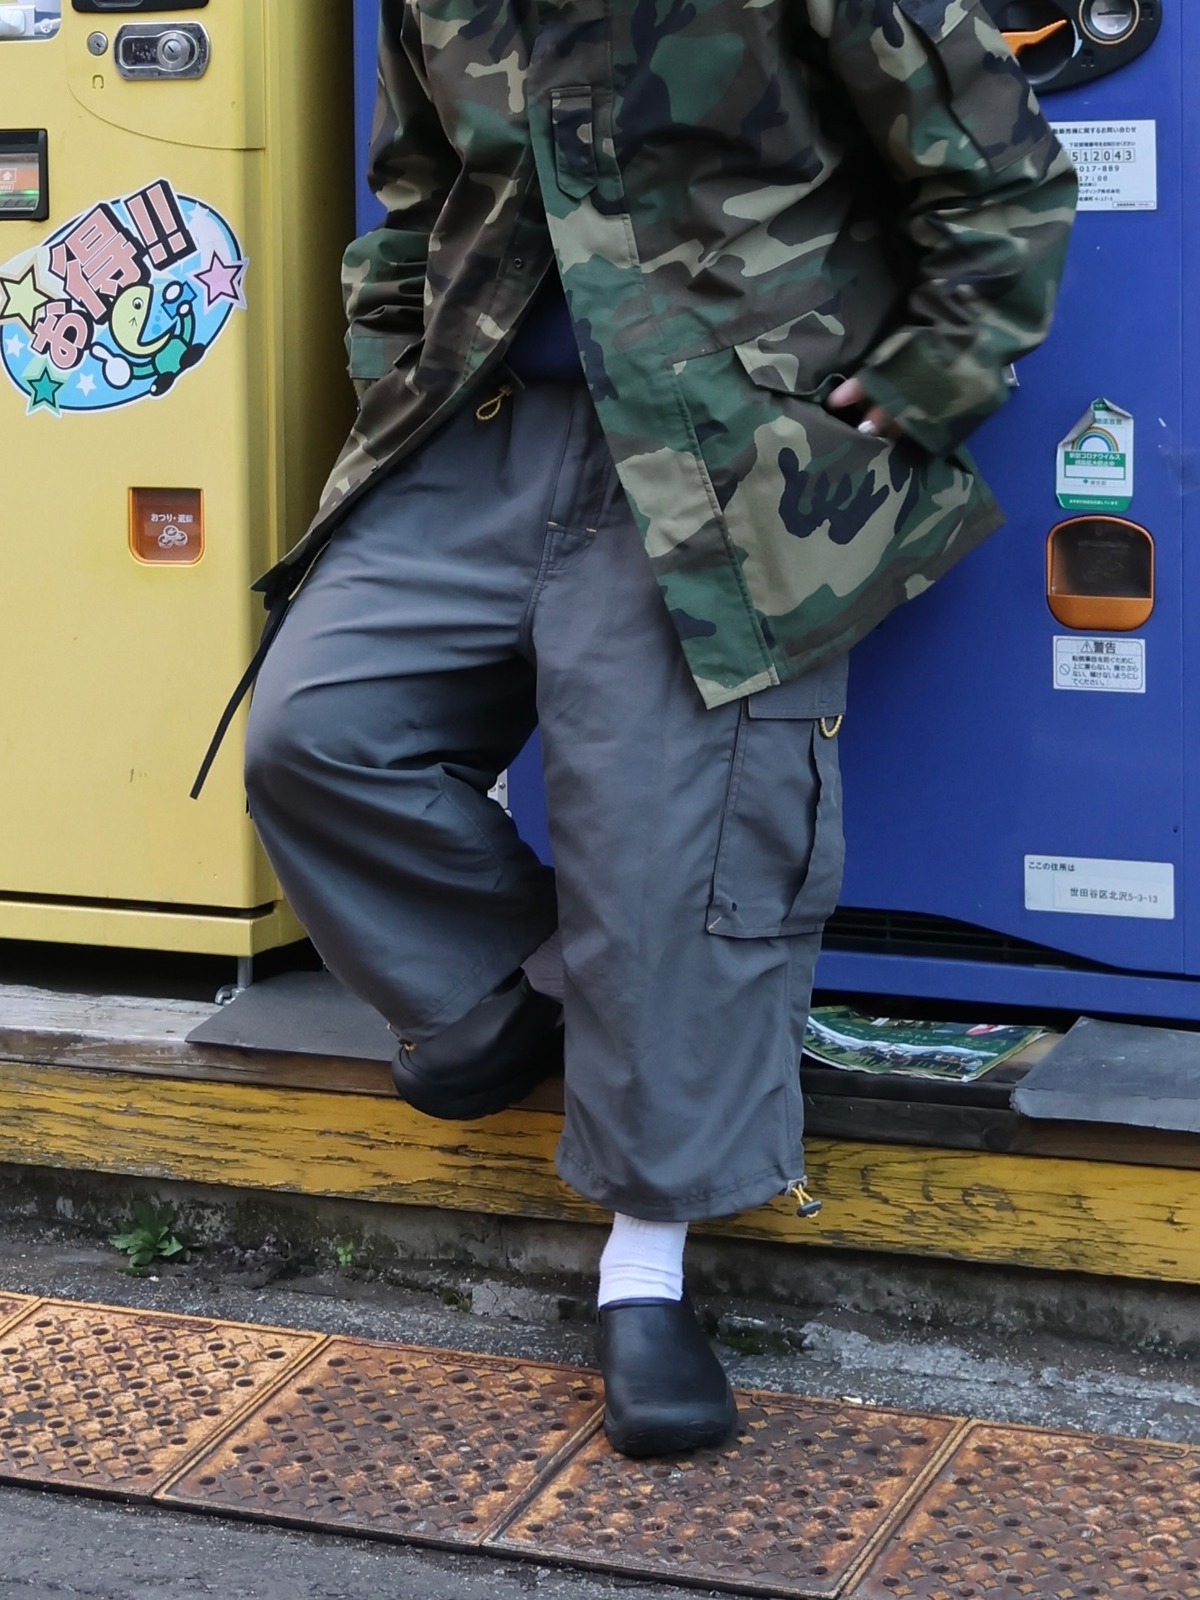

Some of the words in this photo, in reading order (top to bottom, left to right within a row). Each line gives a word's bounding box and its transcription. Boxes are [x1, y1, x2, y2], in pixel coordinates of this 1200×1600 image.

[1072, 150, 1132, 161] 512043
[1094, 641, 1116, 654] 警告
[1028, 861, 1075, 872] ここの住所は
